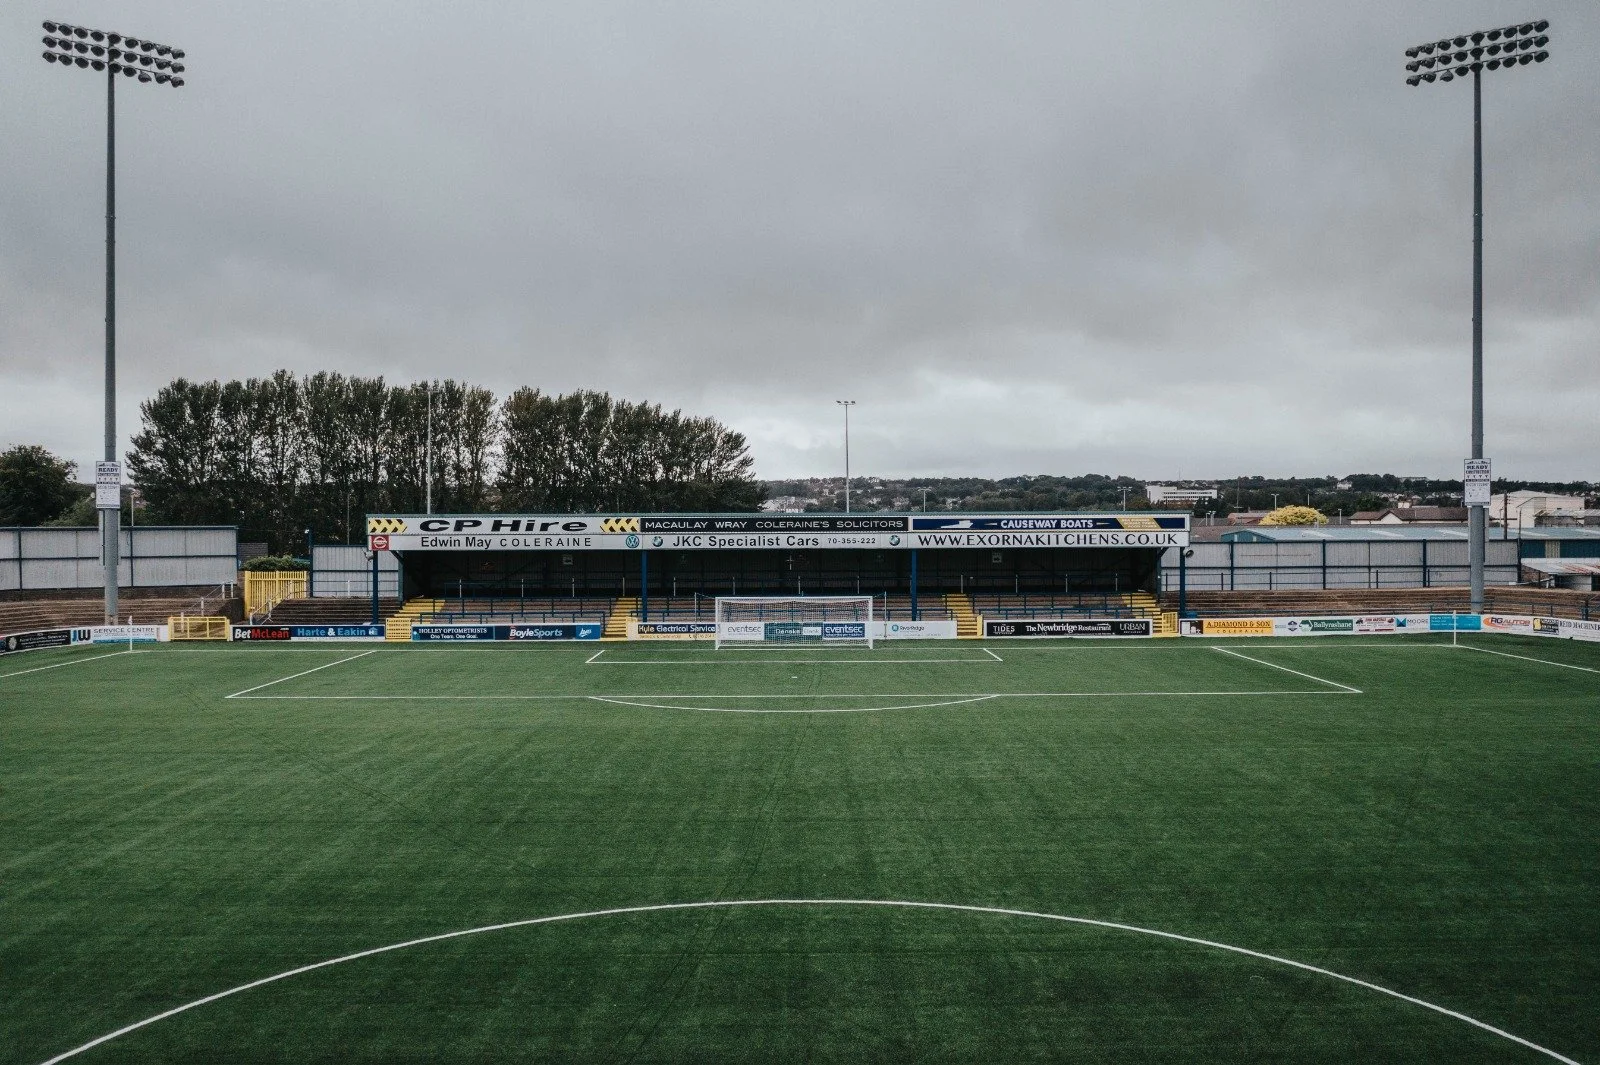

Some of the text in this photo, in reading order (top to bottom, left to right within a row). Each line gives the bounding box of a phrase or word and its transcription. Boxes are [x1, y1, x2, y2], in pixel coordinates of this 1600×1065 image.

[490, 518, 588, 532] Hire
[645, 521, 708, 529] MACAULAY
[756, 520, 830, 528] COLERAINE'S
[836, 520, 904, 528] SOLICITORS
[1000, 519, 1094, 529] CAUSEWAY BOATS
[421, 536, 592, 550] Edwin May COLERAINE
[672, 535, 702, 547] JKC
[708, 535, 781, 549] Specialist
[786, 535, 820, 547] Cars
[918, 533, 1178, 547] WWW.EXORNAKITCHENS.CO.UK
[297, 628, 326, 636] Harte
[327, 628, 336, 636] &
[337, 628, 366, 636] Eakin
[656, 624, 689, 632] Electrical
[727, 625, 762, 633] eventsec
[825, 624, 863, 634] eventsec
[1037, 623, 1078, 634] Newbridge
[1119, 623, 1146, 631] URBAN
[234, 628, 289, 639] BetMcLean
[509, 628, 563, 638] BoyleSports
